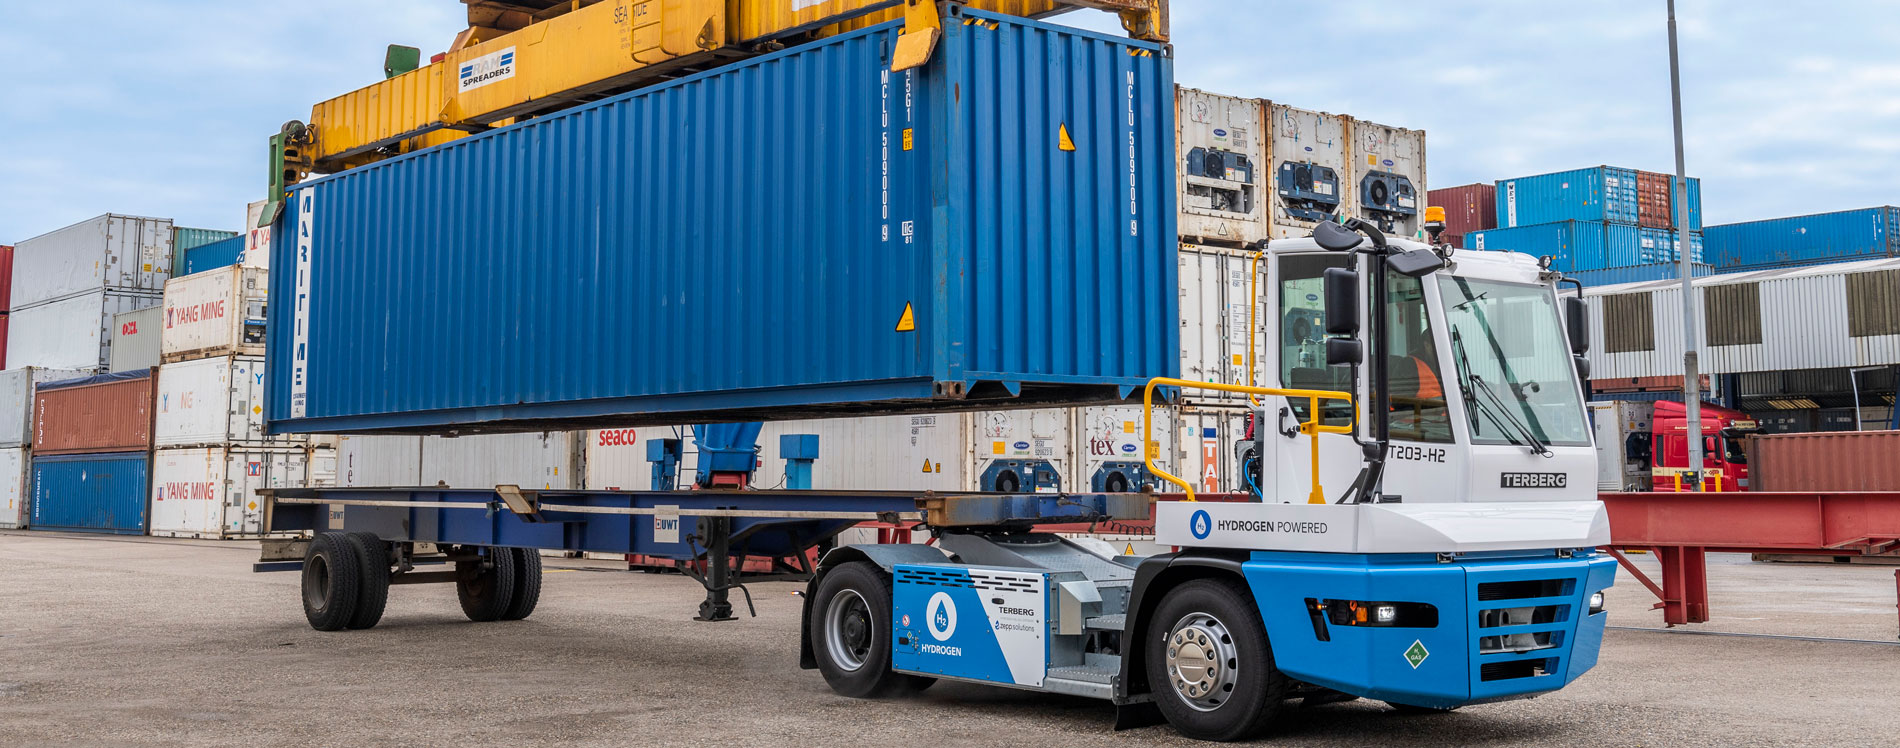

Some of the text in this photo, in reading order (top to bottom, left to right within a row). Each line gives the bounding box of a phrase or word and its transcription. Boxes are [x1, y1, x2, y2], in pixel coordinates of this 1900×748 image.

[614, 5, 628, 24] SEA
[463, 66, 511, 87] SPREADERS
[881, 69, 889, 128] MCLU
[1126, 71, 1134, 126] MCLU
[1131, 220, 1137, 236] 9
[261, 229, 270, 245] YA
[882, 225, 888, 241] 9
[905, 236, 912, 244] 81
[296, 195, 312, 386] MARITIME
[176, 305, 198, 325] YANG
[200, 300, 224, 320] MING
[599, 429, 637, 446] seaco
[1090, 436, 1116, 456] tex
[1389, 445, 1445, 463] T203-H2
[1504, 474, 1566, 487] TERBERG
[166, 482, 188, 500] YANG
[191, 482, 214, 500] MING
[661, 519, 678, 530] UWT
[1218, 520, 1328, 534] HYDROGEN POWERED
[937, 613, 946, 626] H2
[999, 607, 1034, 616] TERBERG
[921, 643, 962, 656] HYDROGEN
